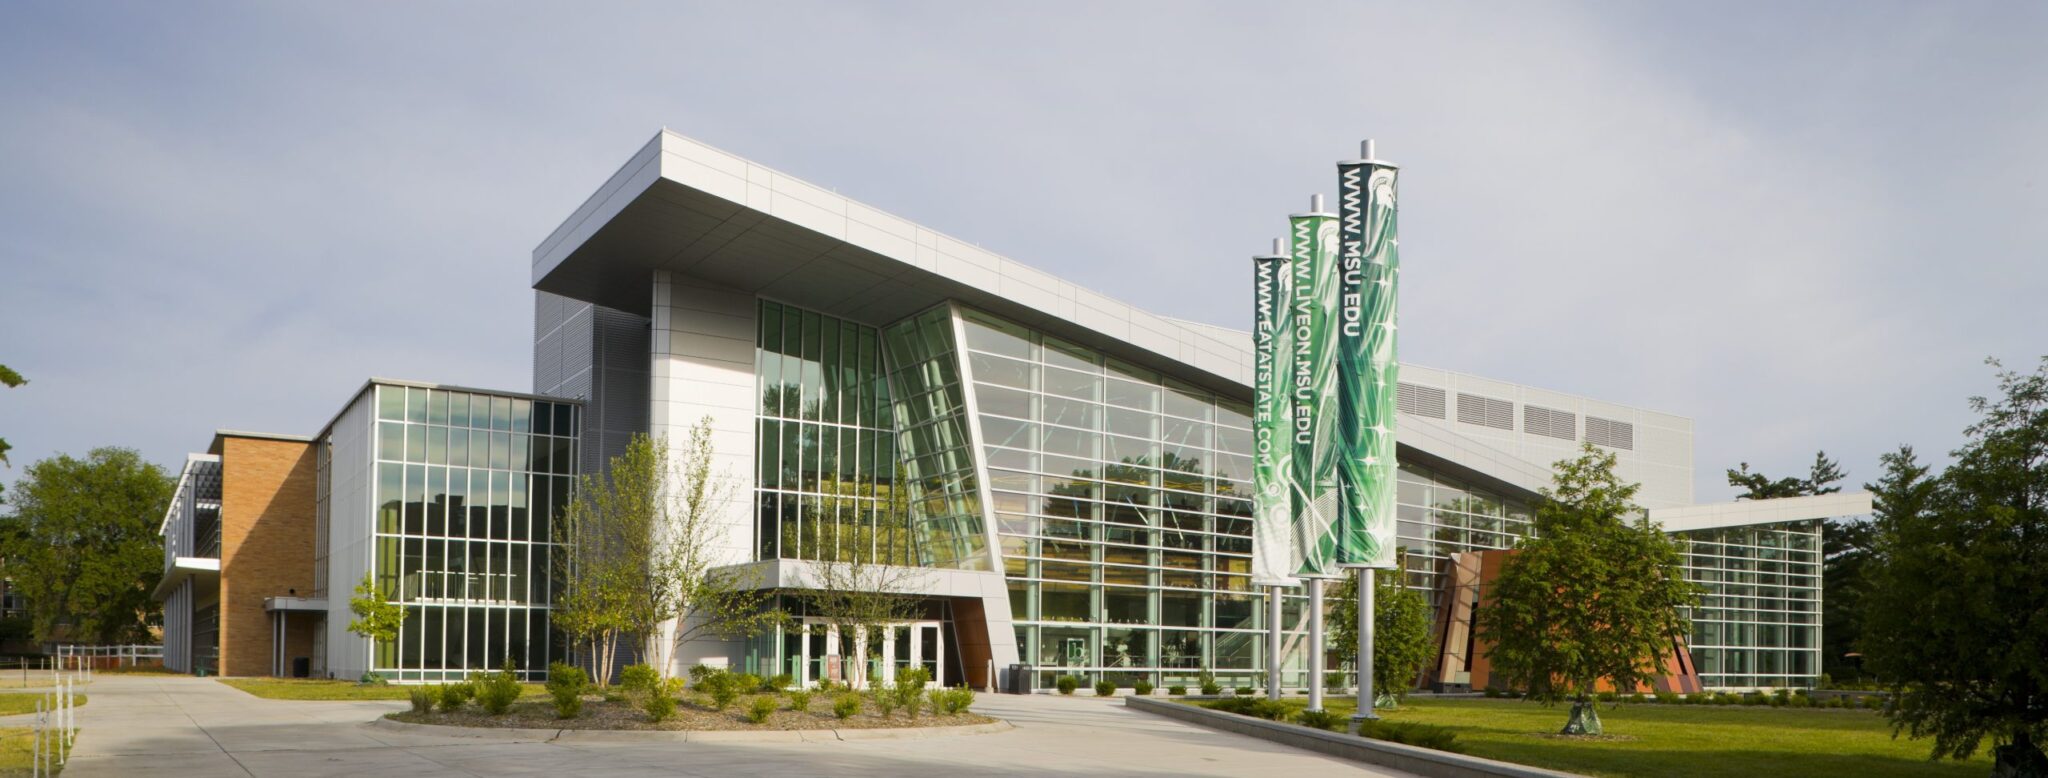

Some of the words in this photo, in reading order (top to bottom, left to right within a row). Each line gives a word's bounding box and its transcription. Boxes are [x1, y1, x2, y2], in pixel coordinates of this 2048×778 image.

[1295, 219, 1312, 445] WWW.LIVEON.MSU.EDU
[1343, 167, 1361, 337] WWW.MSU.EDU
[1257, 260, 1273, 467] WWW.EATATSTATE.COM
